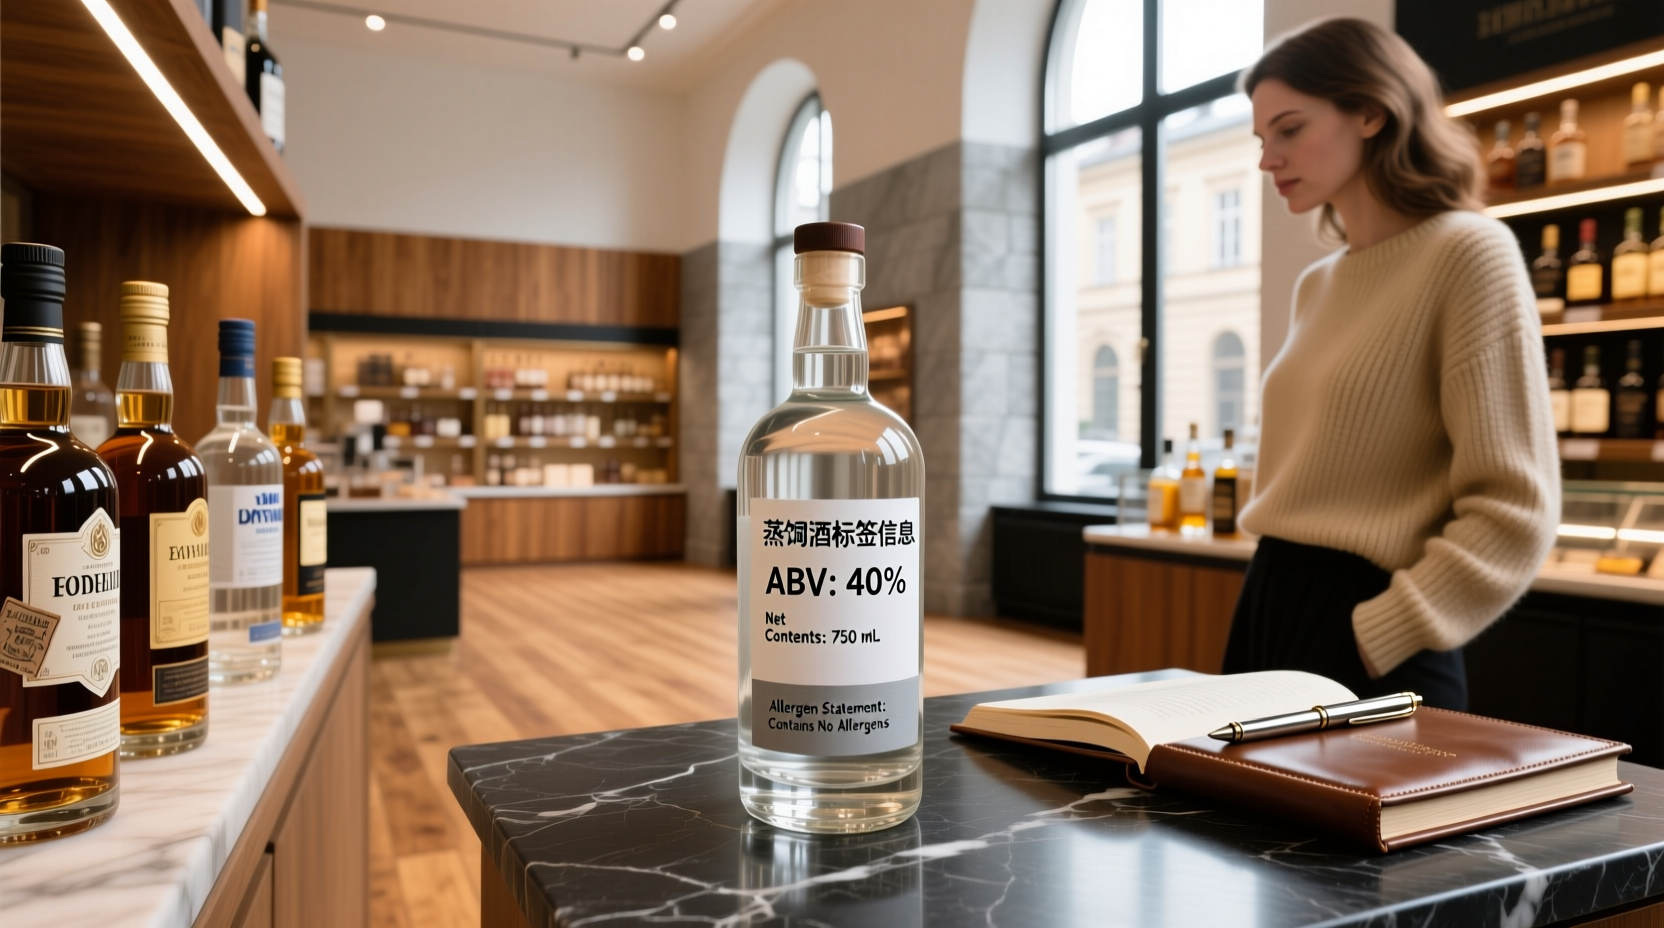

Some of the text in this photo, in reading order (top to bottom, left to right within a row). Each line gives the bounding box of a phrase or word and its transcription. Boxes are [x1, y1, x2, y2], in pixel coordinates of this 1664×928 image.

[766, 566, 905, 596] ABV: 40%
[766, 612, 786, 625] Net
[765, 628, 880, 644] Contents: 750 mL
[768, 699, 886, 717] Allergen Statement:
[768, 718, 890, 734] Contains No Allergens
